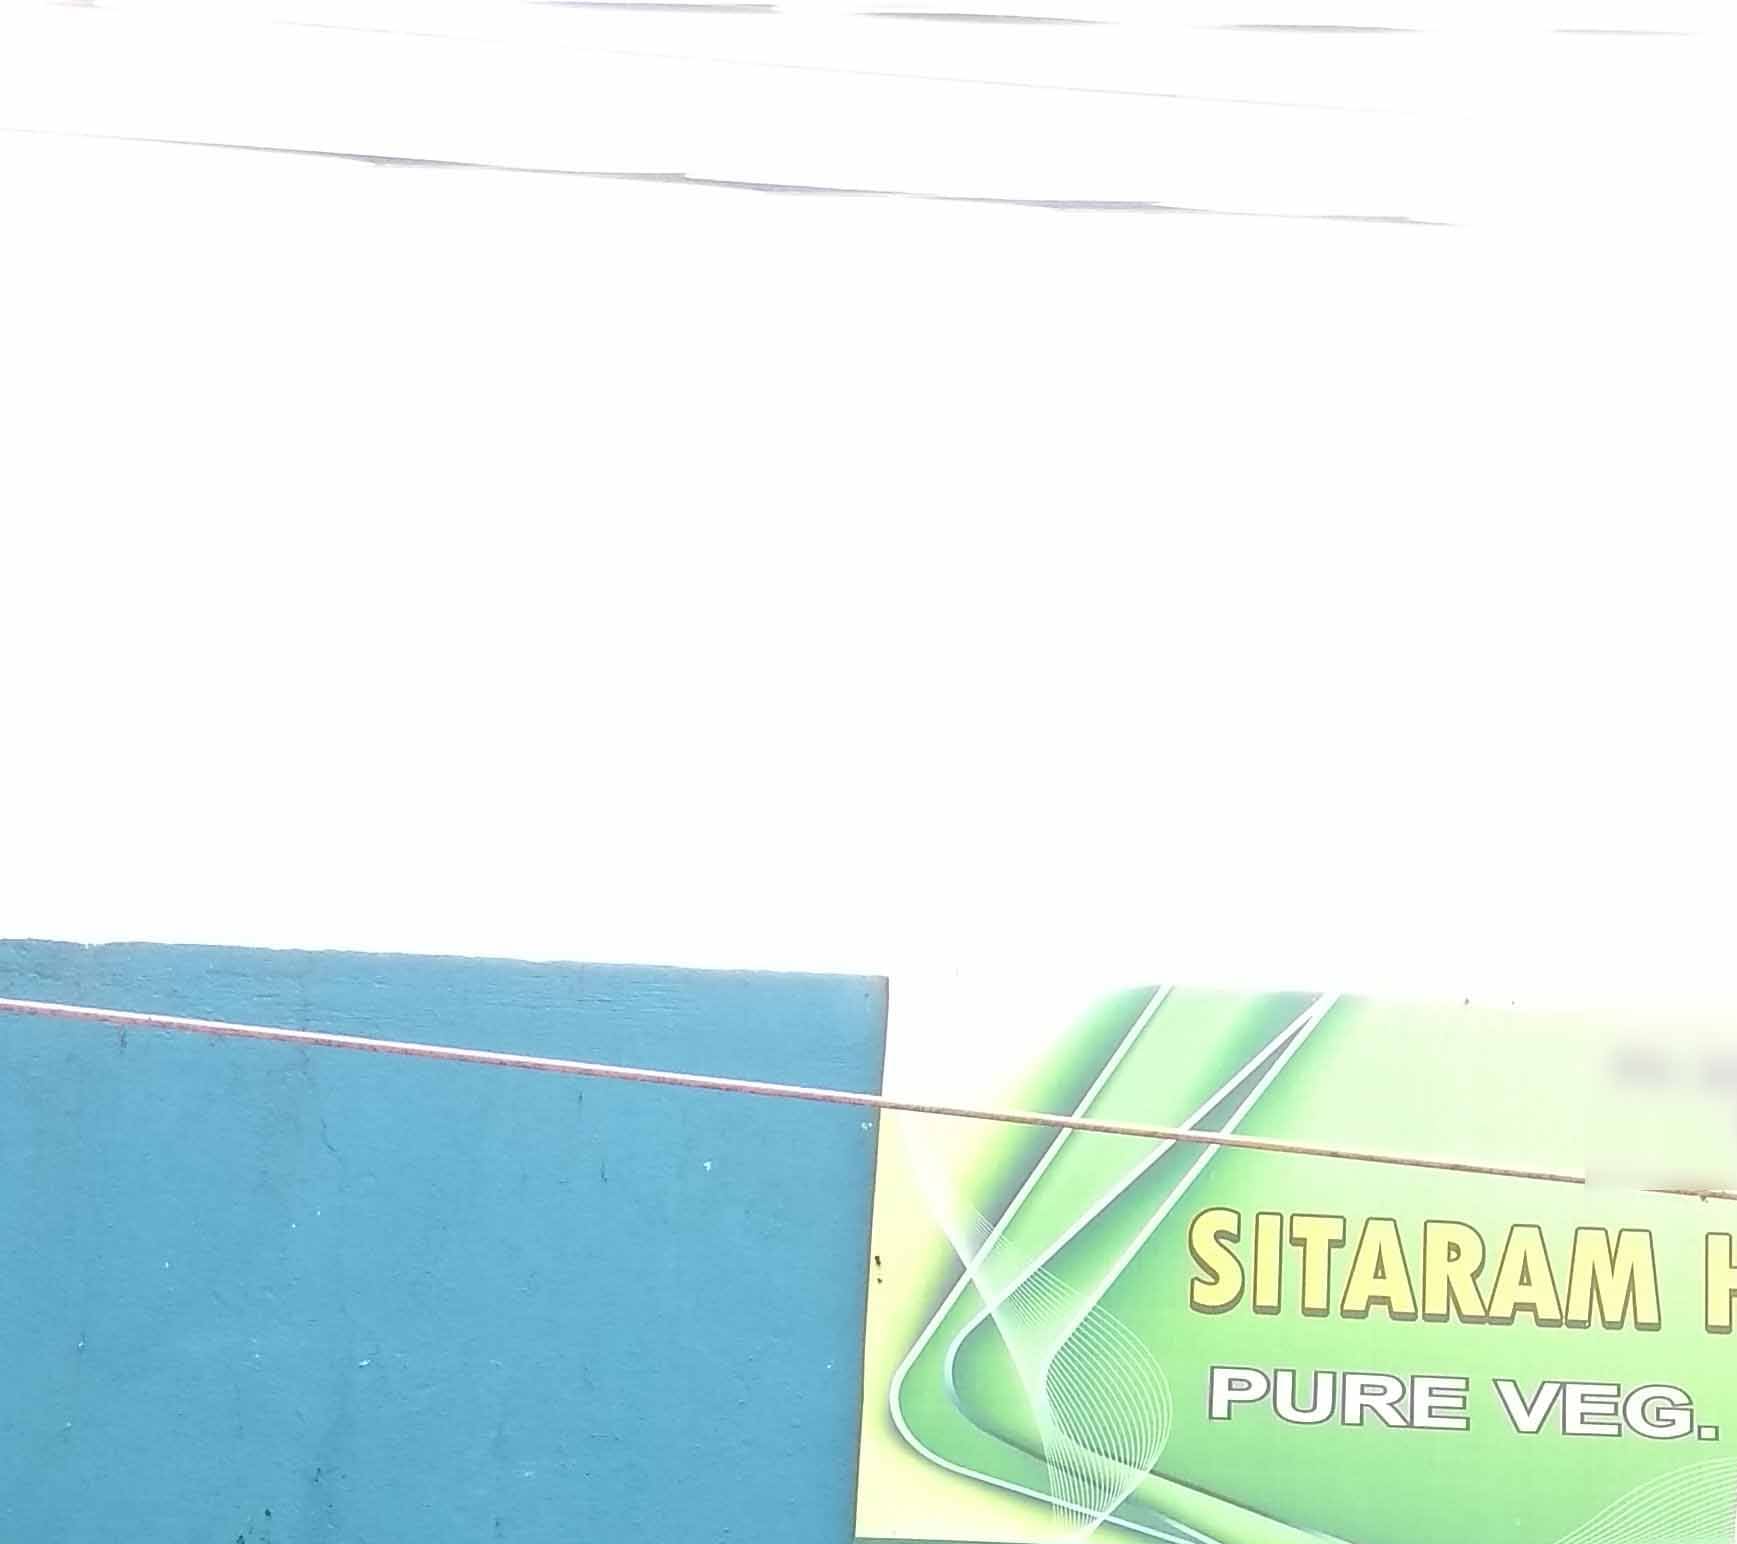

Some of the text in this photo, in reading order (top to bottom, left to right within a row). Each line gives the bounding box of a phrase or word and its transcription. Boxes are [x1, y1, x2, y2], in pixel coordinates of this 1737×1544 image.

[1188, 1207, 1661, 1330] SITARAM
[1208, 1366, 1720, 1441] PURE VEG.
